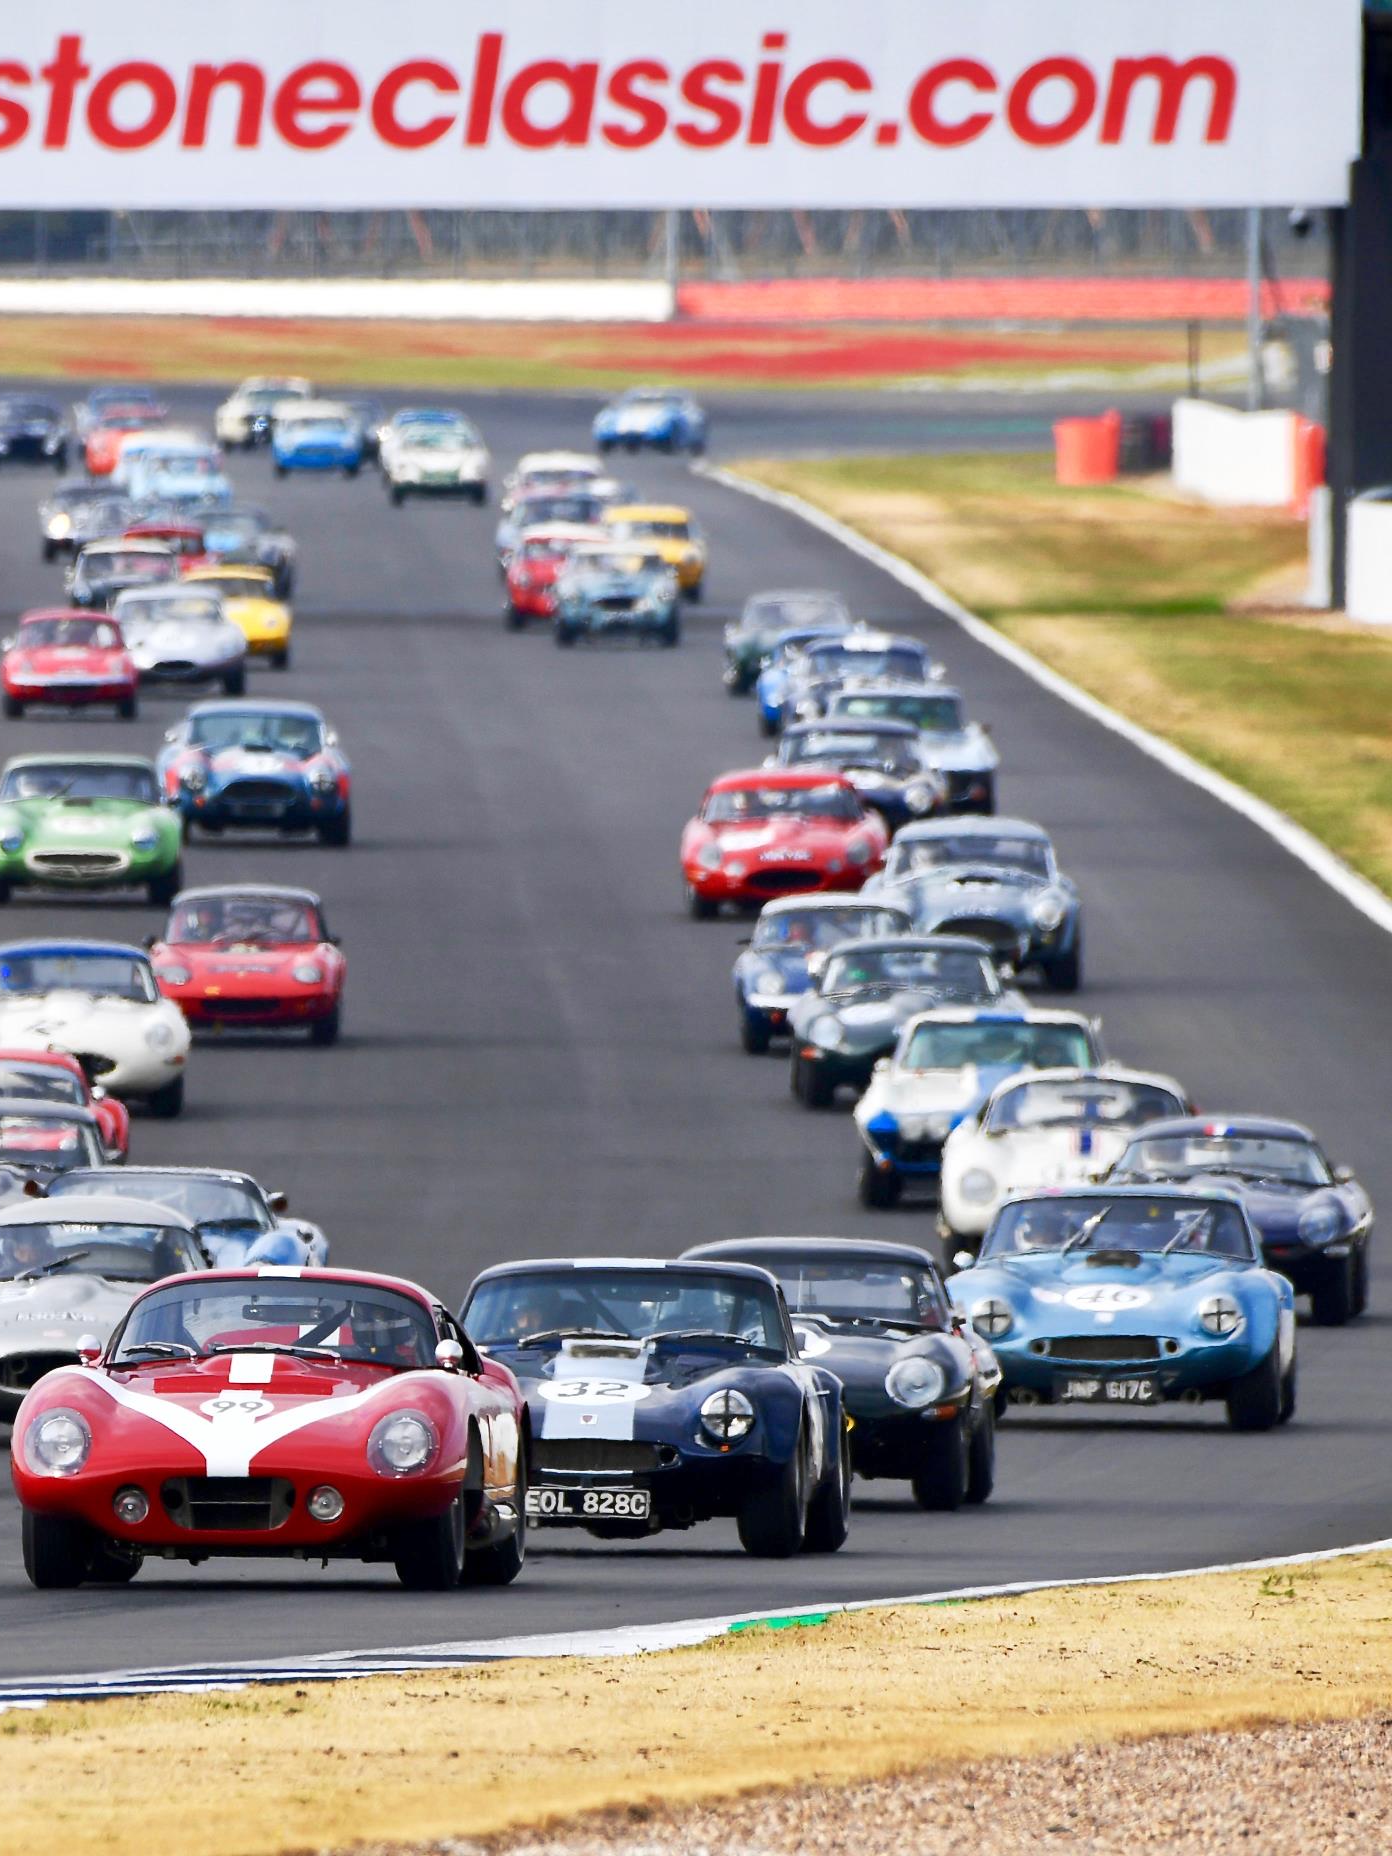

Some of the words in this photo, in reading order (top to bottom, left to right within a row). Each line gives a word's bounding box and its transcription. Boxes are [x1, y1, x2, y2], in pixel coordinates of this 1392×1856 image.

[557, 1382, 629, 1397] 32
[212, 1401, 264, 1413] 99
[524, 1490, 573, 1513] EOL
[582, 1492, 645, 1515] 828C
